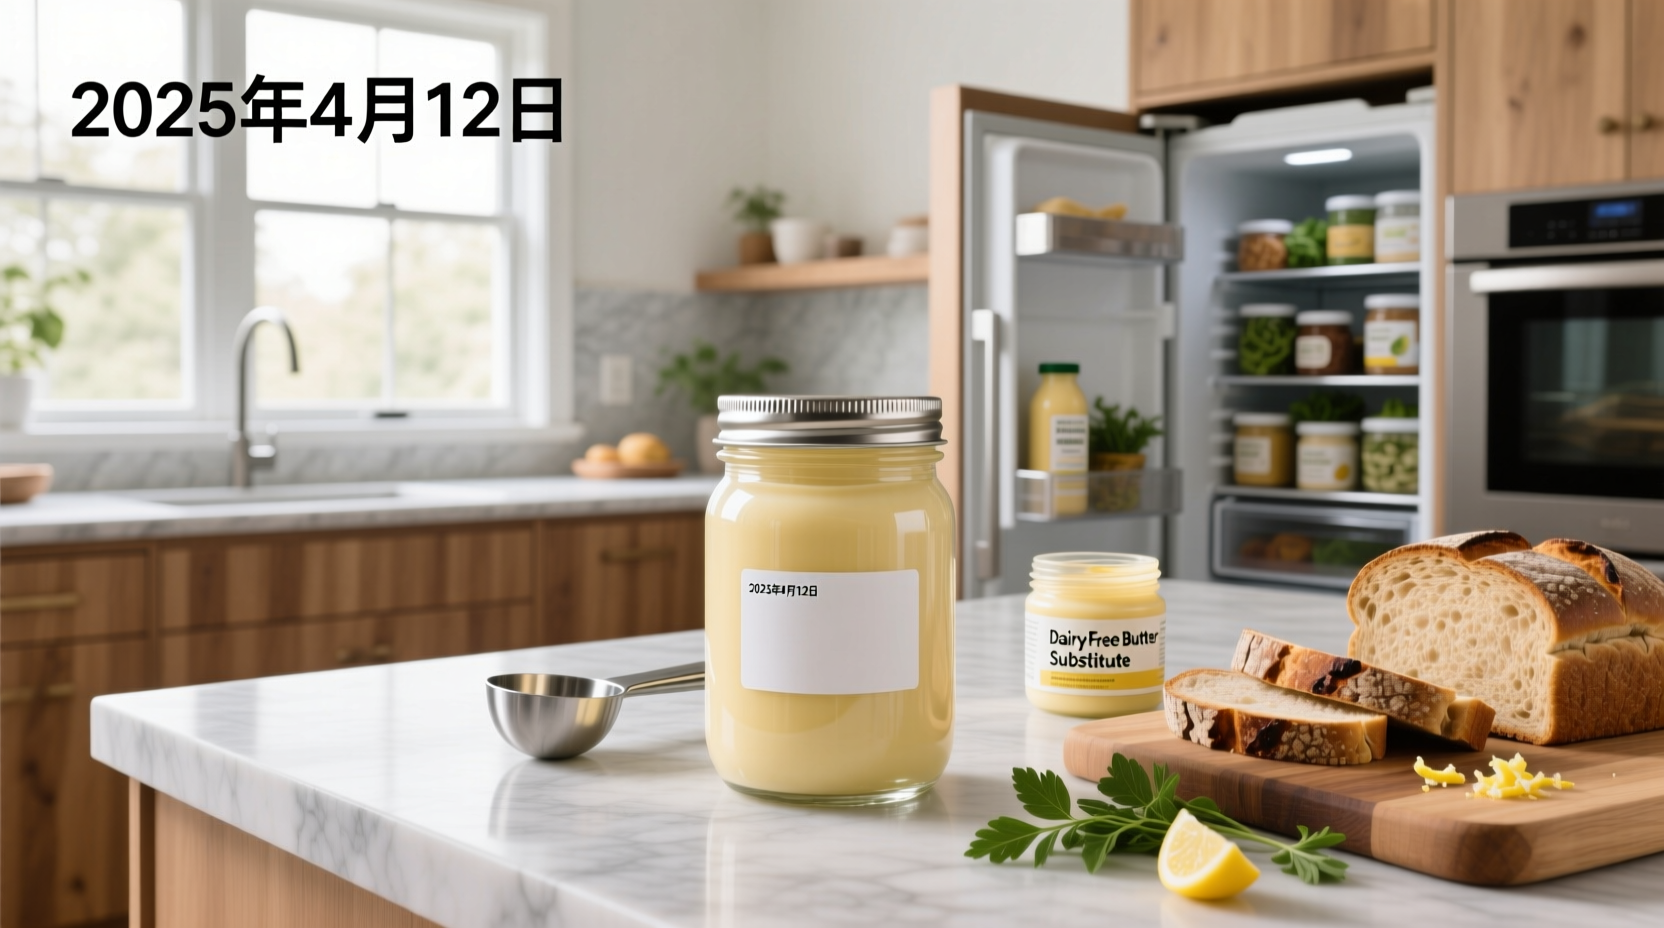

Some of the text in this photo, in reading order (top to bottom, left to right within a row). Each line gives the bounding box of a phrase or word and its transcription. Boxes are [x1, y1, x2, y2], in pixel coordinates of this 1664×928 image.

[1050, 629, 1159, 651] Dairy Free Butter
[1049, 650, 1131, 668] Substitute
